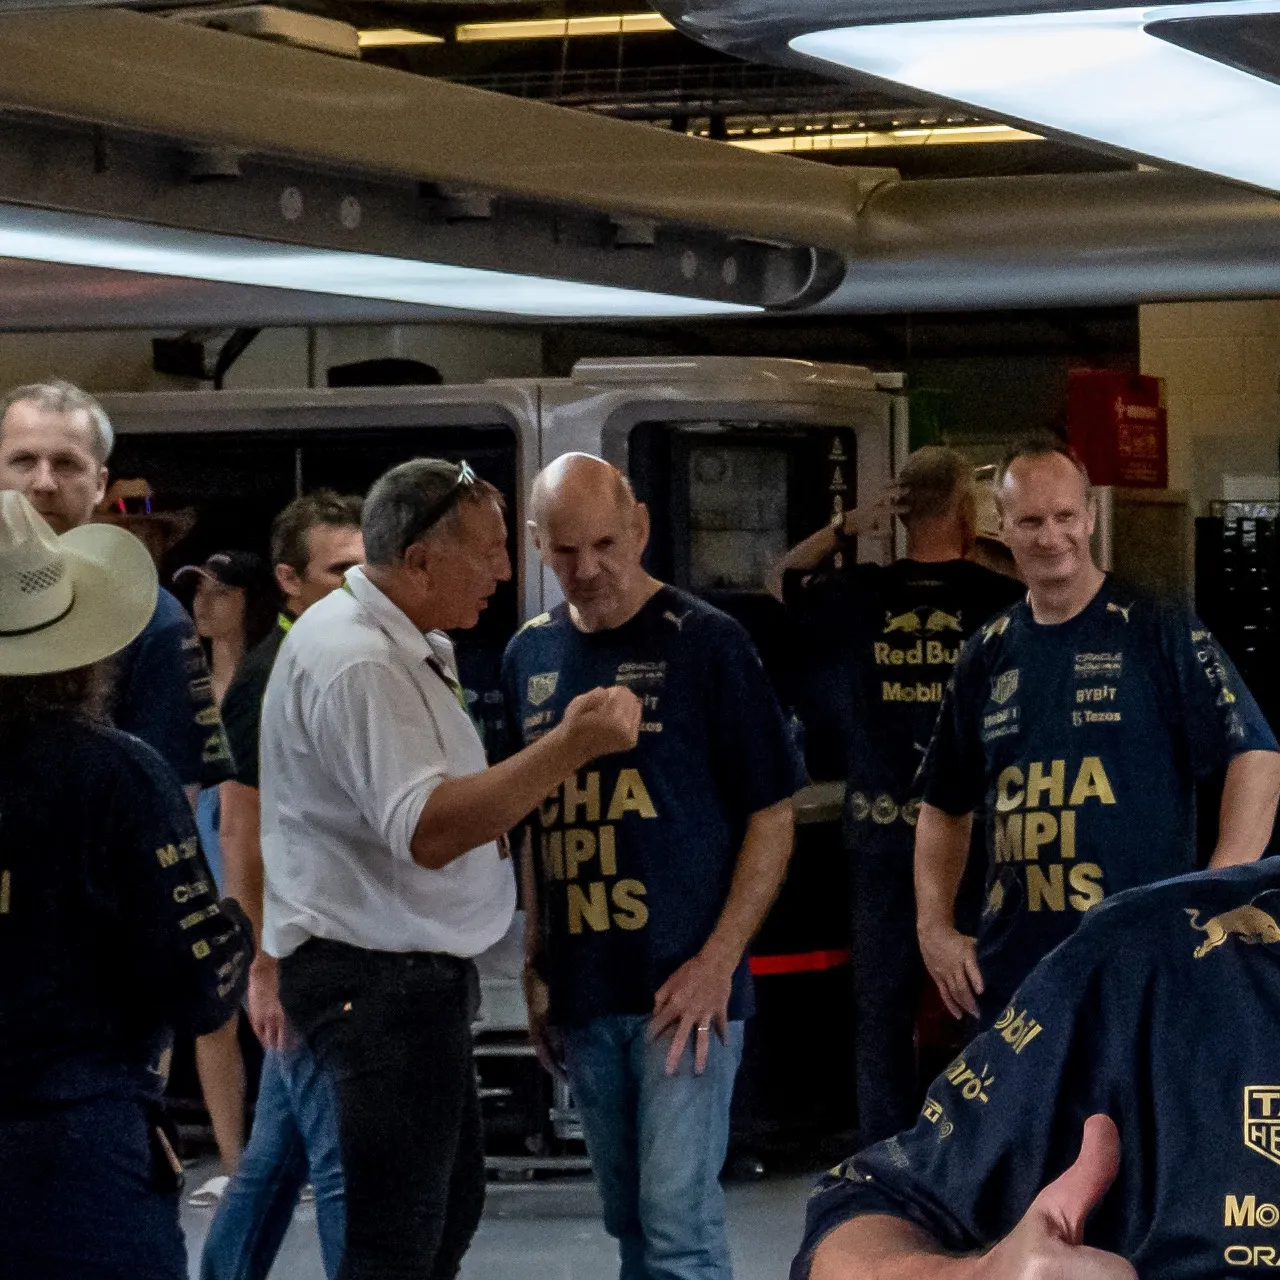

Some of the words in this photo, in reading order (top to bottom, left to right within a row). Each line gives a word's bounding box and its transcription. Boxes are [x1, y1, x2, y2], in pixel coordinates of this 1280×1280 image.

[874, 640, 923, 664] Red
[926, 640, 965, 664] Bu
[882, 681, 943, 702] Mobil
[995, 756, 1117, 813] CHA
[994, 810, 1076, 863] MPI
[566, 878, 651, 935] NS
[1026, 862, 1105, 912] NS
[994, 1007, 1044, 1055] obil
